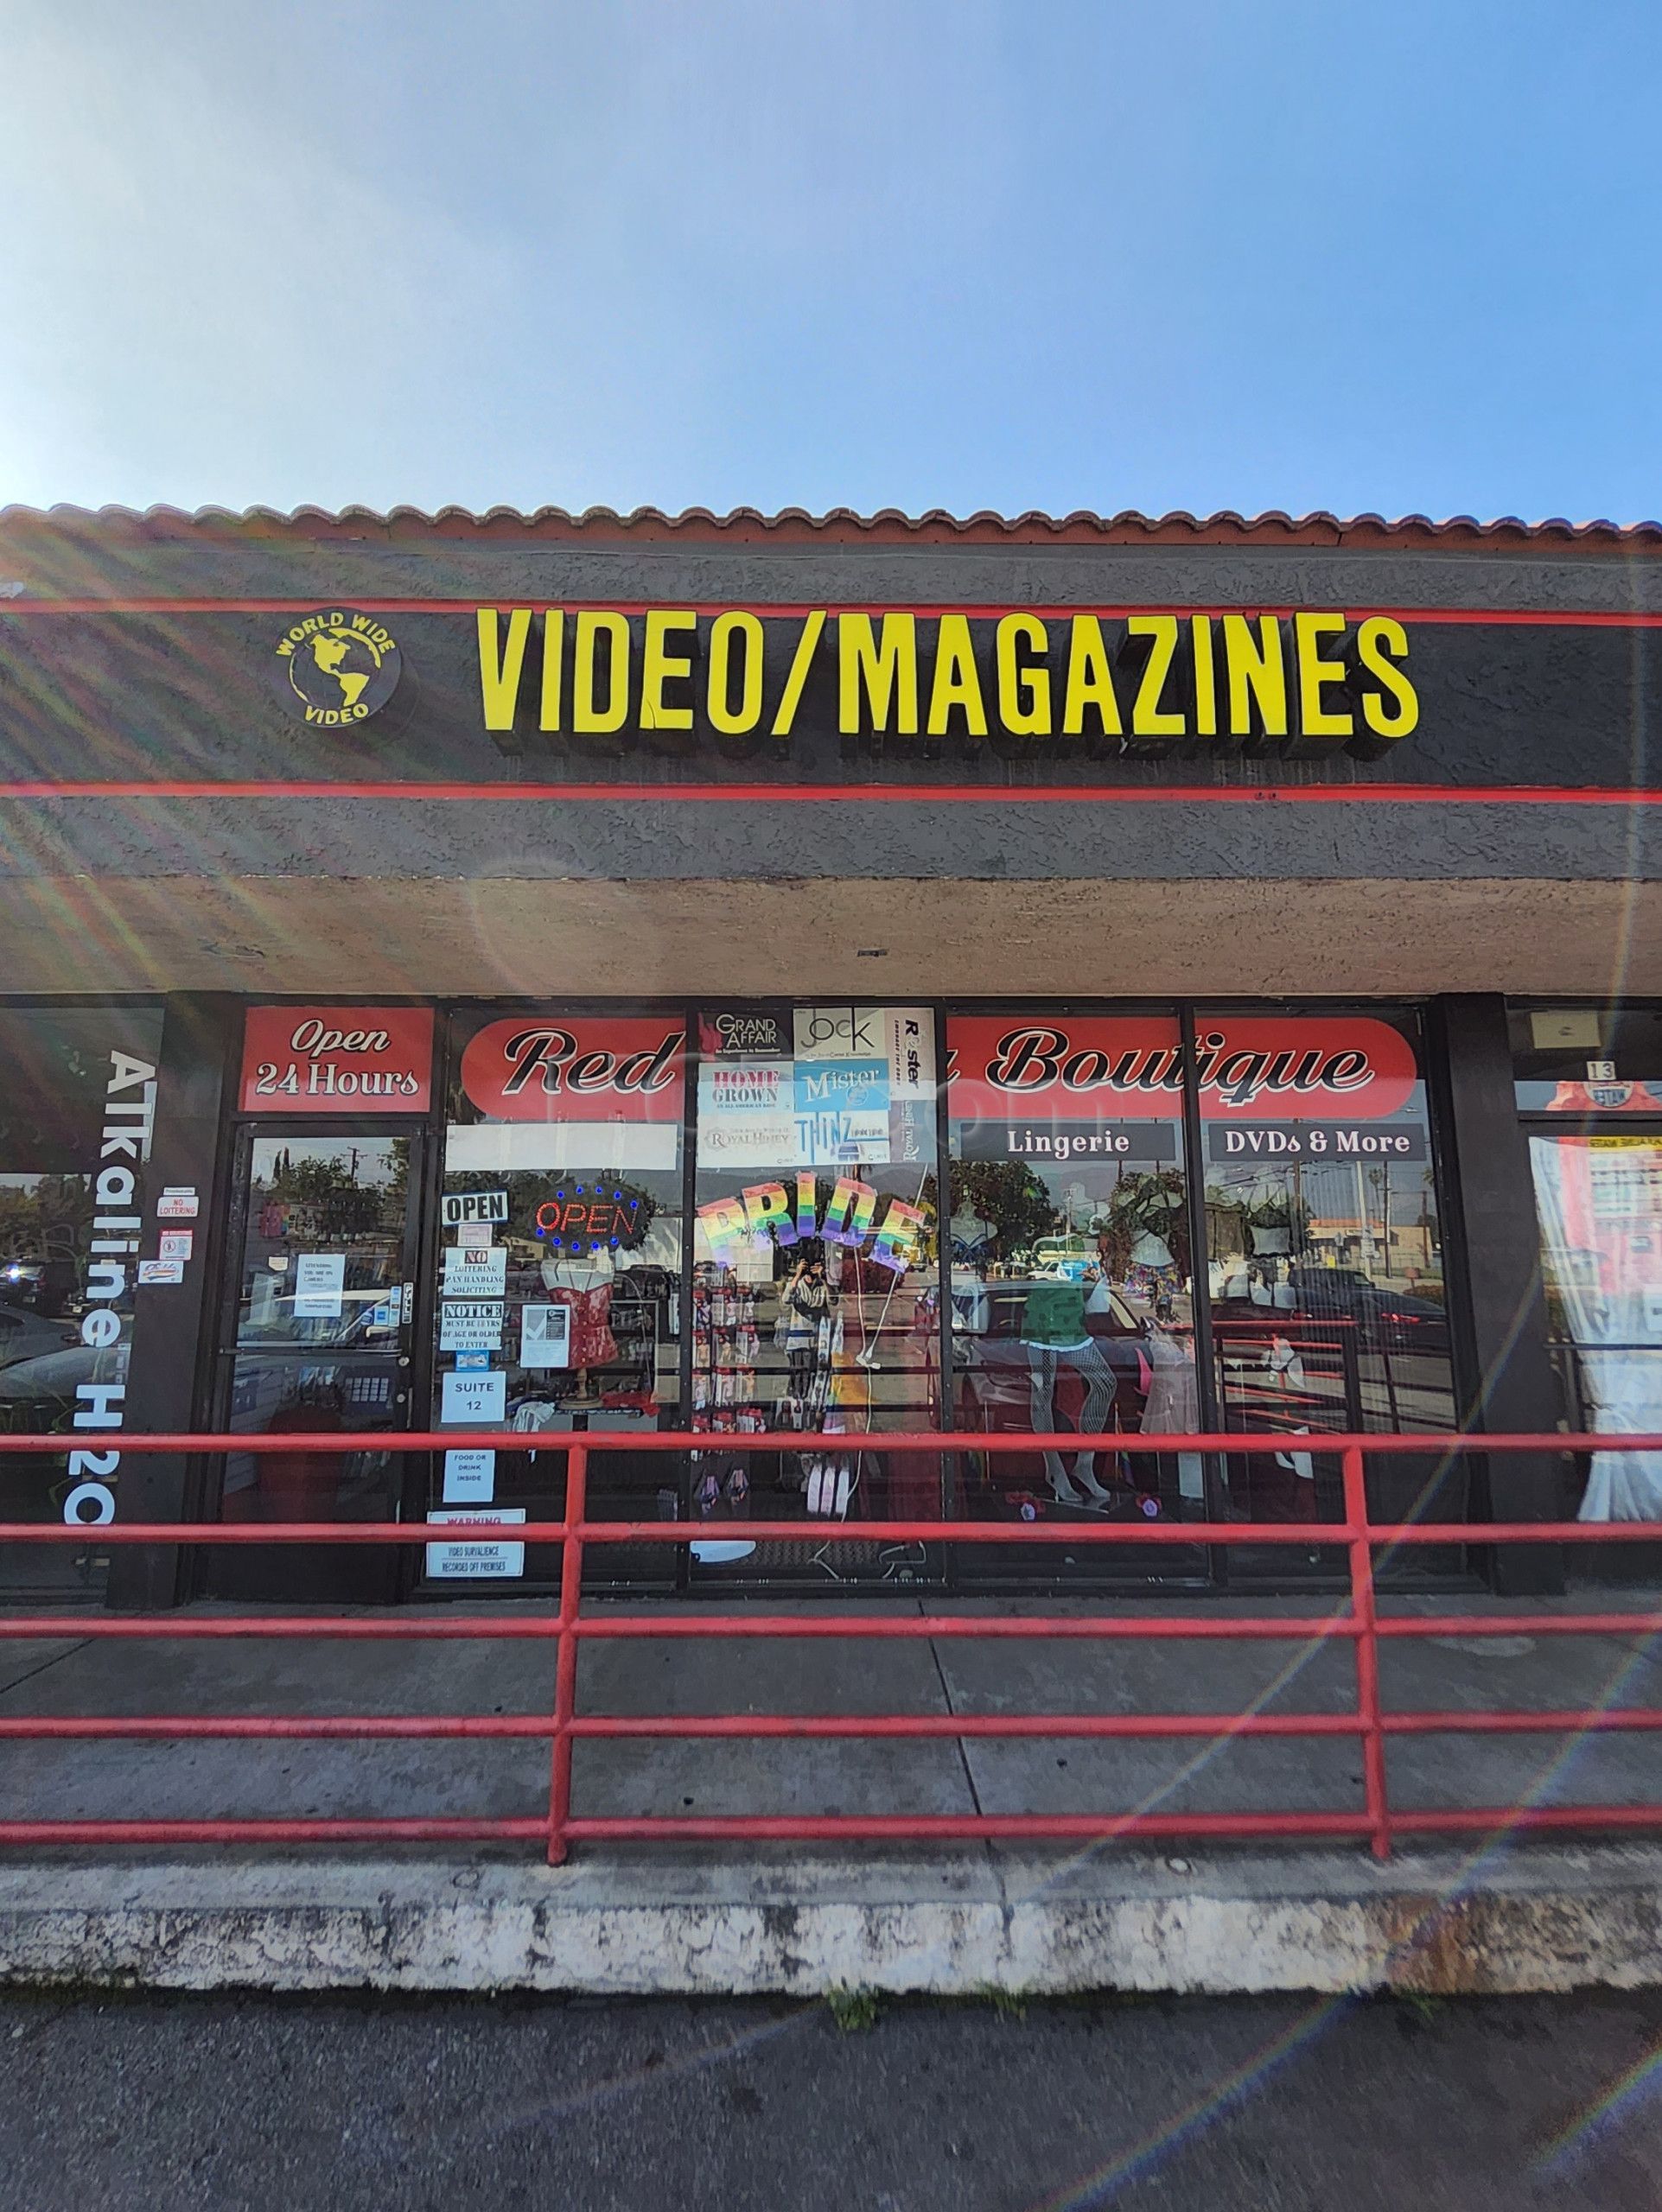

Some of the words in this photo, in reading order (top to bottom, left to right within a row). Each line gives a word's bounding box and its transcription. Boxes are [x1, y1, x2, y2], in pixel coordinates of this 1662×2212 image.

[276, 612, 344, 657] WORLD
[351, 614, 396, 654] WIDE
[305, 702, 369, 725] VIDEO
[716, 1014, 776, 1034] GRAND
[290, 1019, 391, 1059] Open
[726, 1031, 777, 1048] AFFAIR
[500, 1027, 687, 1096] Red
[1590, 1063, 1613, 1077] 13
[256, 1063, 299, 1095] 24
[306, 1063, 419, 1095] Hours
[713, 1070, 780, 1088] HOME
[802, 1070, 880, 1103] Mister
[712, 1088, 778, 1103] GROWN
[1007, 1130, 1130, 1160] Lingerie
[1225, 1130, 1301, 1153] DVDs
[1309, 1130, 1328, 1153] &
[1335, 1130, 1410, 1153] More
[82, 1050, 156, 1348] Alkaline
[446, 1194, 504, 1223] OPEN
[535, 1201, 638, 1236] OPEN
[697, 1170, 926, 1274] PRIDE
[465, 1251, 487, 1263] NO
[445, 1305, 500, 1318] NOTICE
[455, 1382, 494, 1393] SUITE
[466, 1401, 481, 1410] 12
[64, 1384, 126, 1524] H2O
